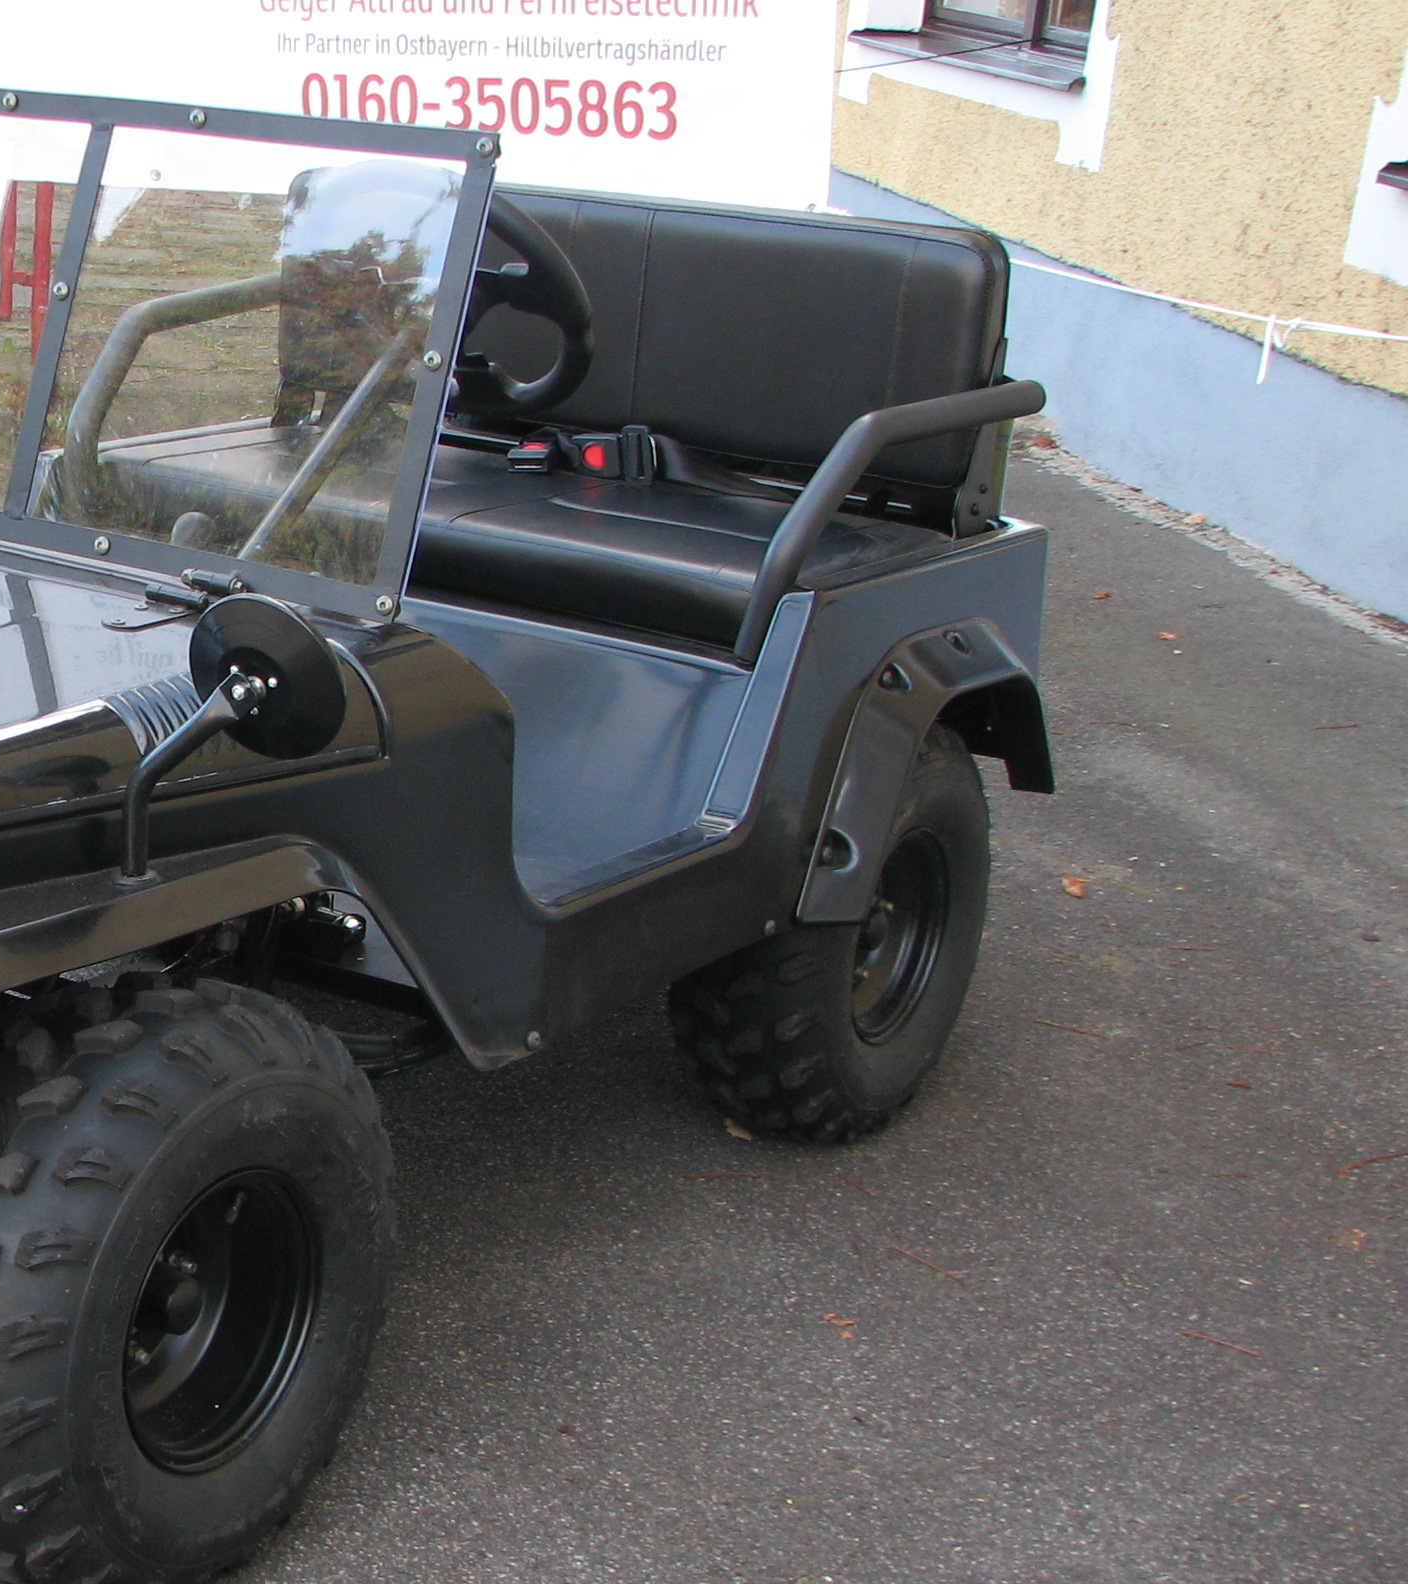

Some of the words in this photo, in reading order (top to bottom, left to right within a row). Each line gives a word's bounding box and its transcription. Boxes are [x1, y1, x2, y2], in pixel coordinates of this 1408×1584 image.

[277, 33, 300, 53] Ihr
[306, 33, 371, 54] Partner
[376, 34, 391, 54] in
[396, 34, 488, 61] Ostbayern
[506, 36, 727, 66] Hillbilvertragshändler
[302, 73, 677, 139] 0160-3505863
